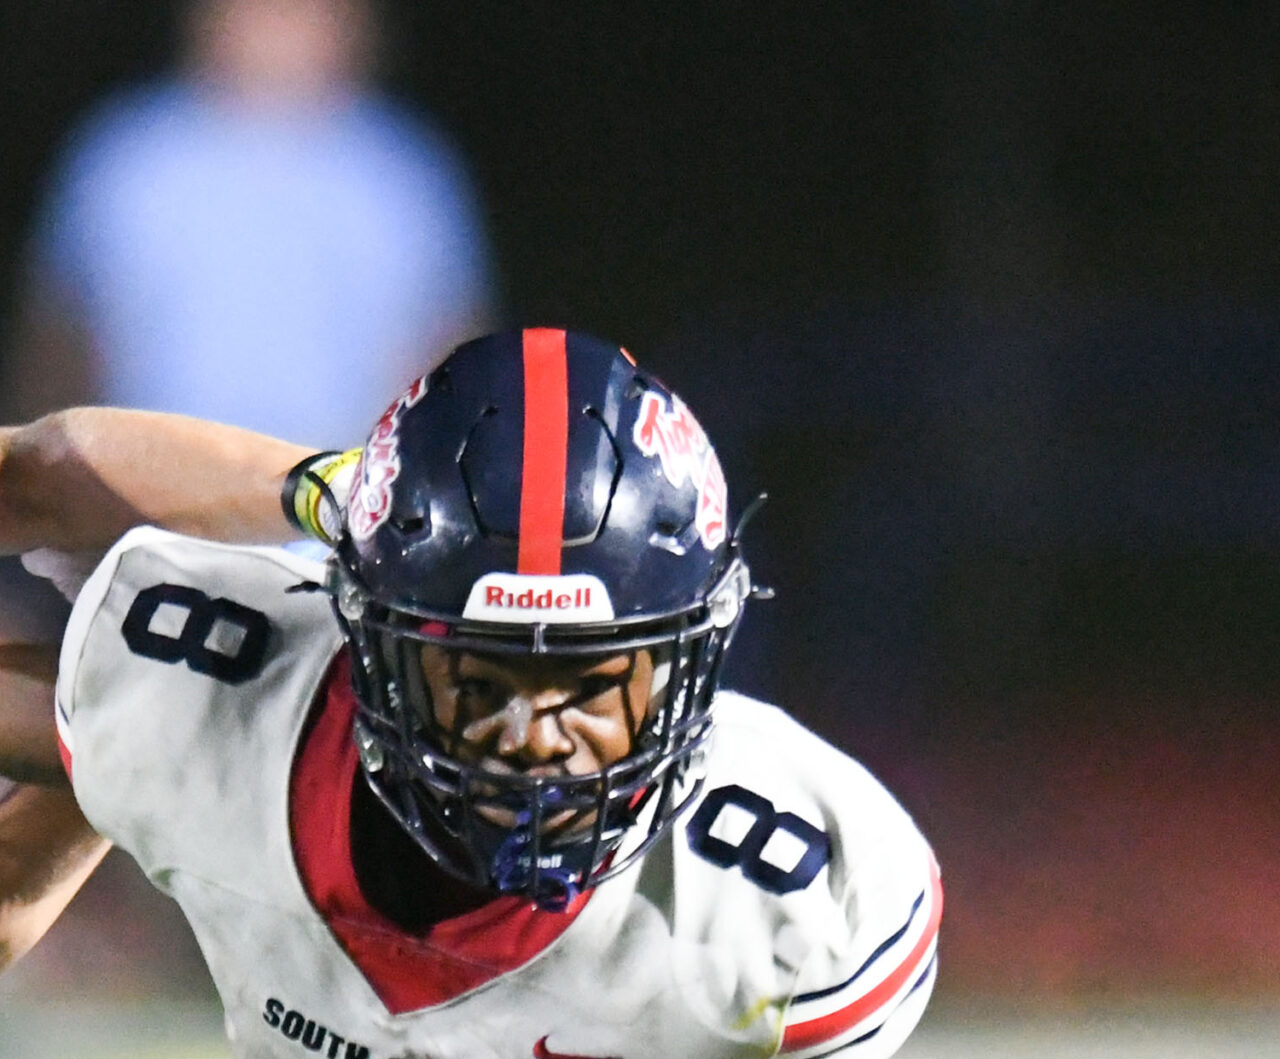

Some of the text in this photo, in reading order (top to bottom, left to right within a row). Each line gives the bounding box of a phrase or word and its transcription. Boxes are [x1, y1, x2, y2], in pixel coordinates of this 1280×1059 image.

[121, 582, 272, 685] 8
[485, 585, 591, 609] Riddell
[686, 784, 832, 895] 8
